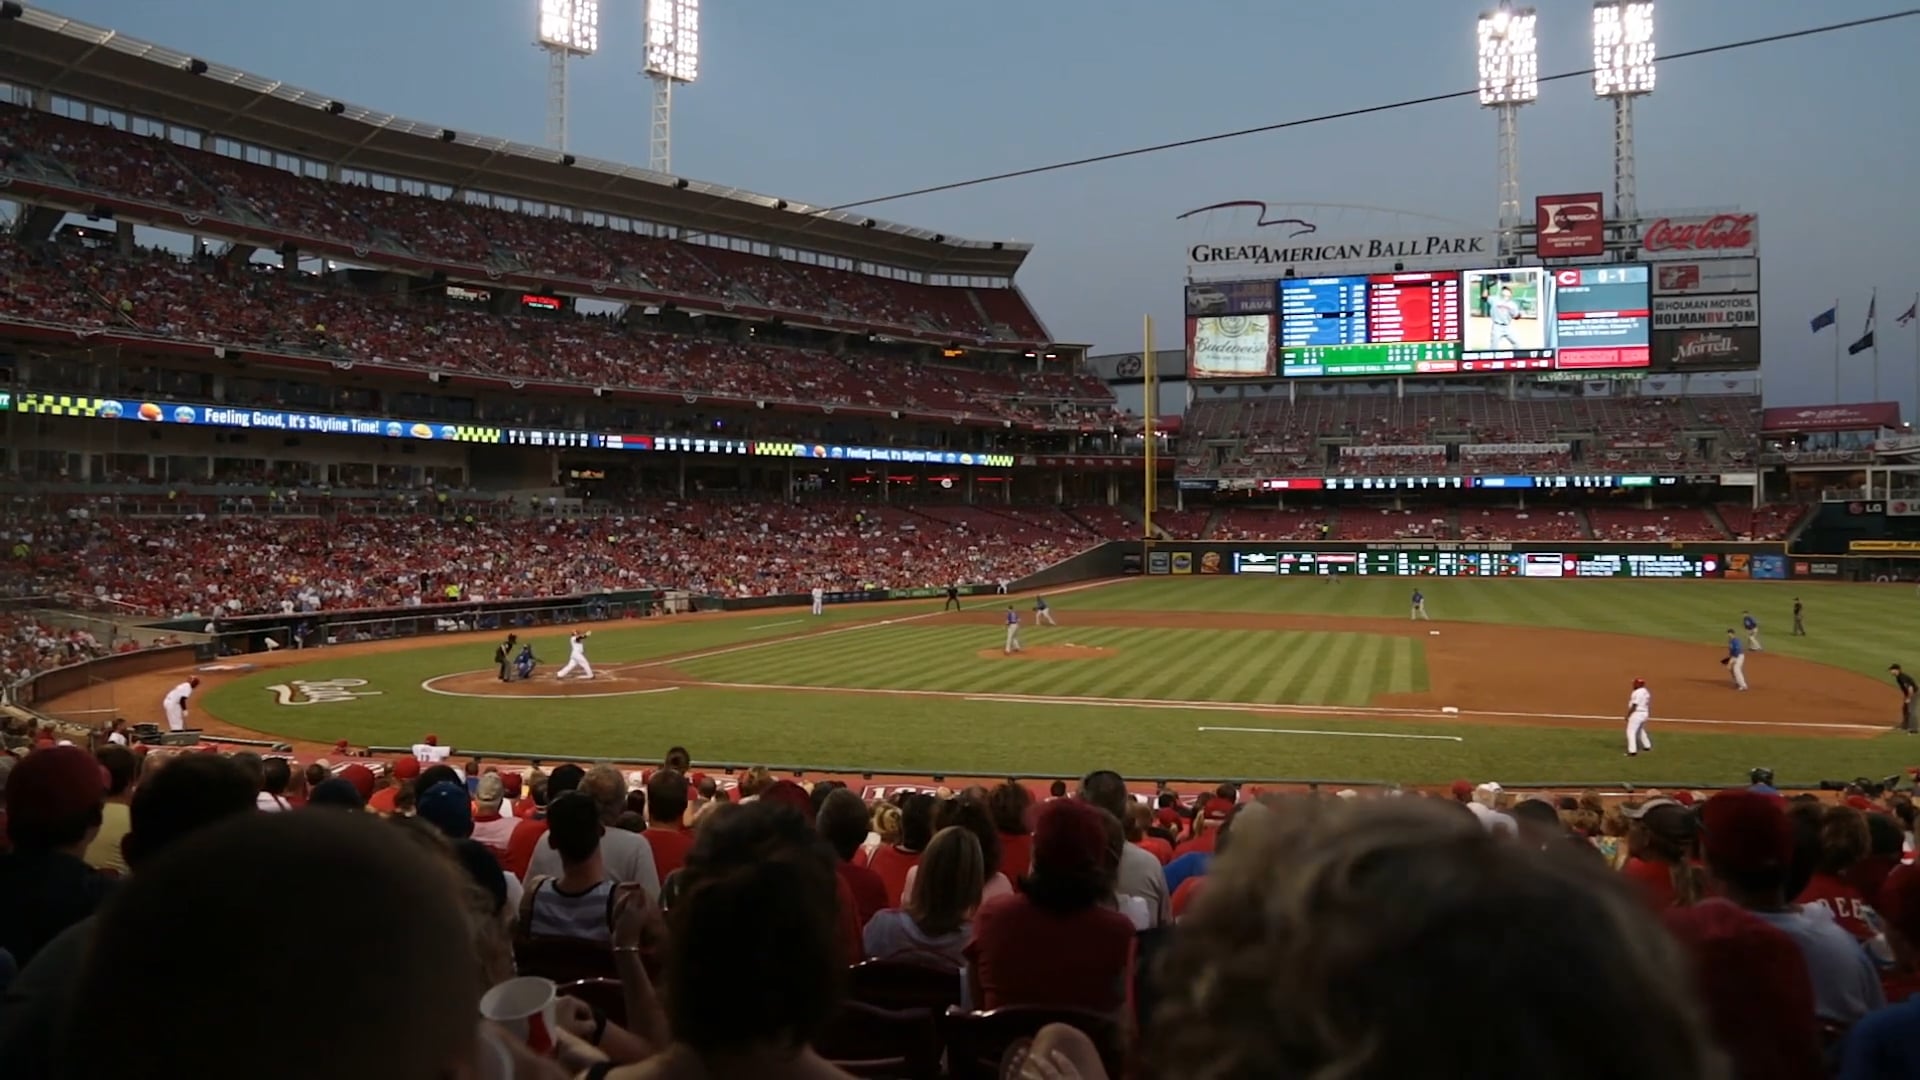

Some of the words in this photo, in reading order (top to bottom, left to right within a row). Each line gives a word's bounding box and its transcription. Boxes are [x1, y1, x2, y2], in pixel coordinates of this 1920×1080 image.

[1644, 213, 1756, 252] Coca-Cola
[1191, 244, 1262, 263] GREAT
[1254, 243, 1364, 265] AMERICAN
[1367, 239, 1422, 258] BALL
[1420, 236, 1486, 255] PARK
[1240, 300, 1273, 310] RAV4
[1665, 300, 1708, 311] HOLMAN
[1654, 310, 1757, 326] HOLMANRV.COM
[1671, 337, 1740, 362] Morrell
[204, 407, 250, 427] Feeling
[252, 411, 286, 429] Good,
[288, 414, 306, 428] It's
[309, 416, 348, 432] Skyline
[350, 418, 380, 433] Time!
[846, 447, 871, 461] Feeling
[902, 450, 925, 463] Skyline
[1865, 503, 1883, 513] LG
[1910, 503, 1920, 512] L
